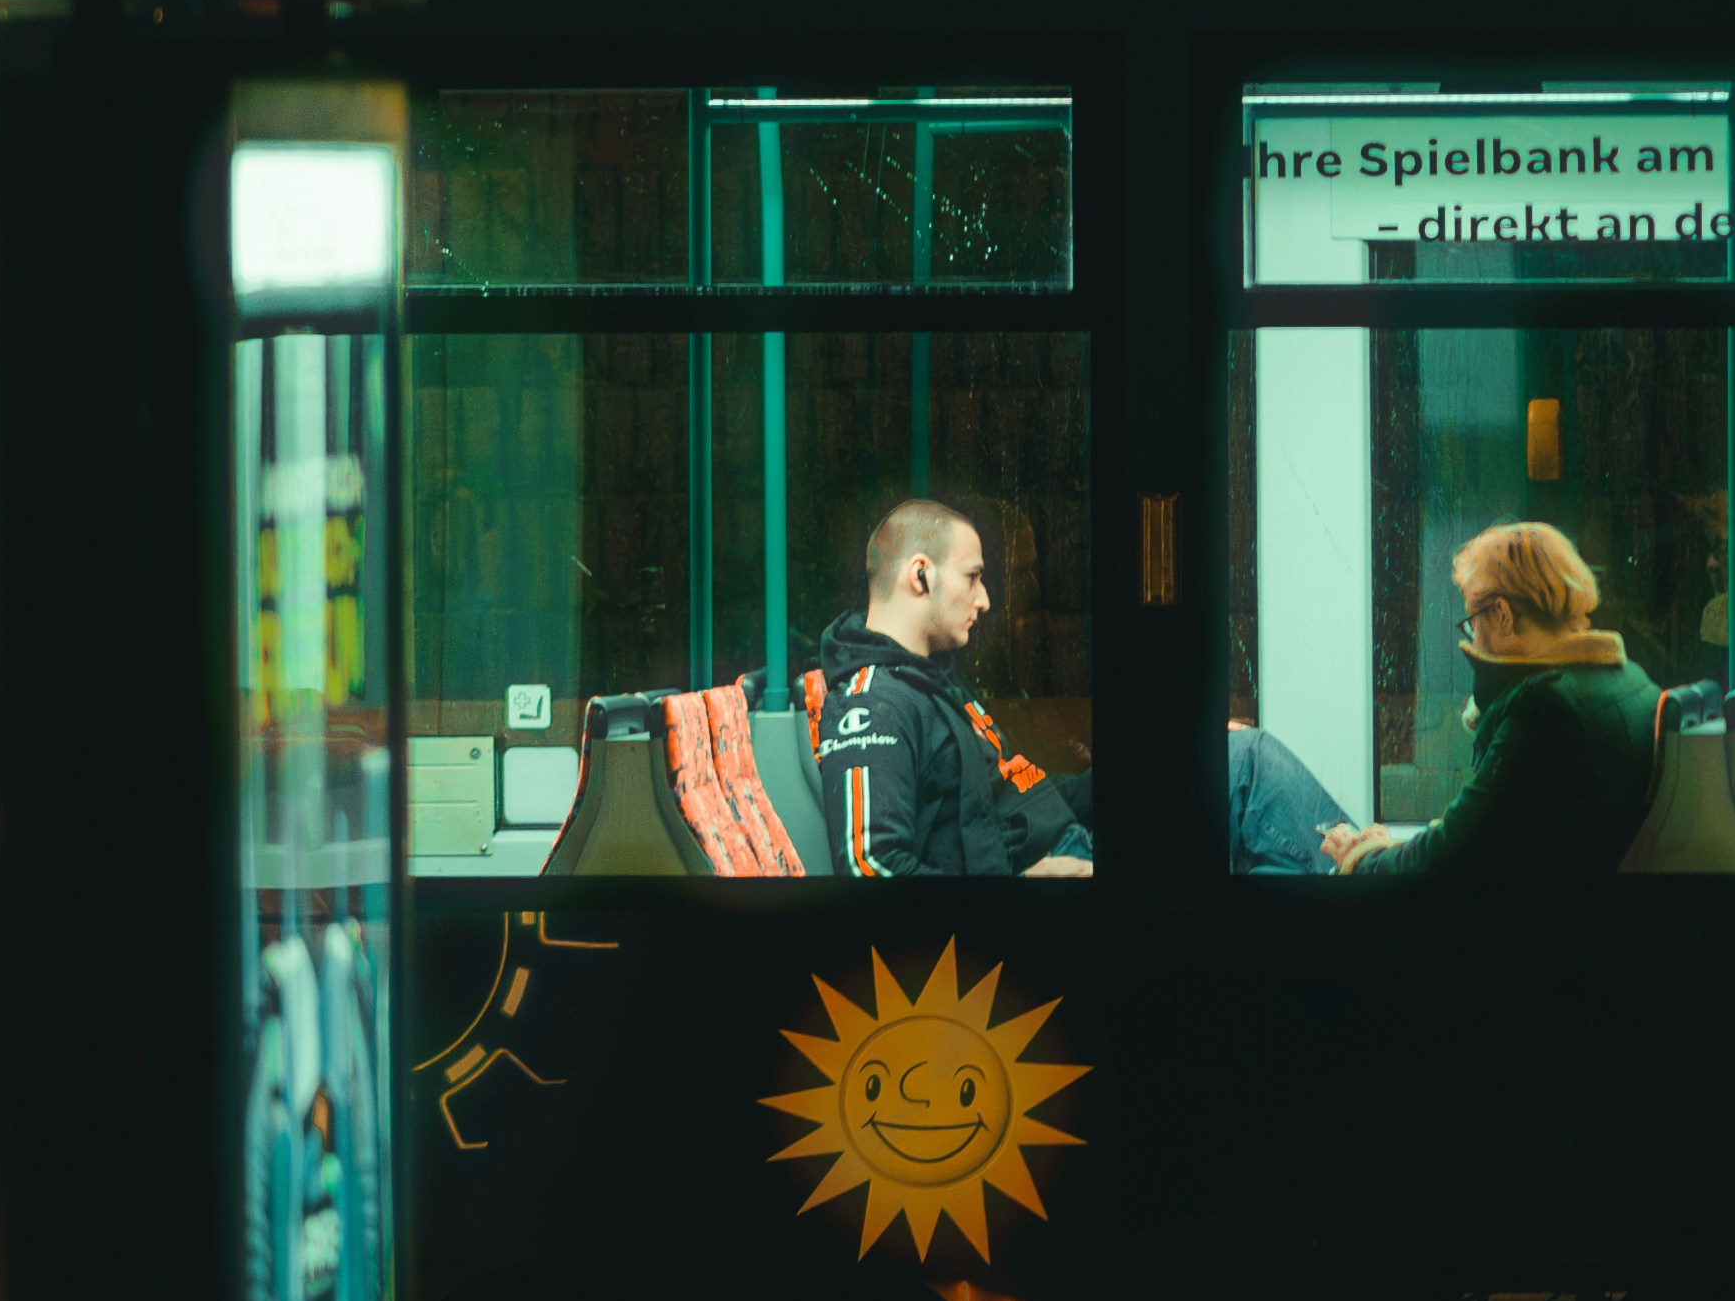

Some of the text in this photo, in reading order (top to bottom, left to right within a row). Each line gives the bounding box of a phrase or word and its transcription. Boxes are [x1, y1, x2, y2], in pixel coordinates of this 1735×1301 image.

[1358, 135, 1620, 187] Spielbank
[1636, 143, 1714, 174] am
[1417, 203, 1578, 242] direkt
[1596, 212, 1656, 241] an
